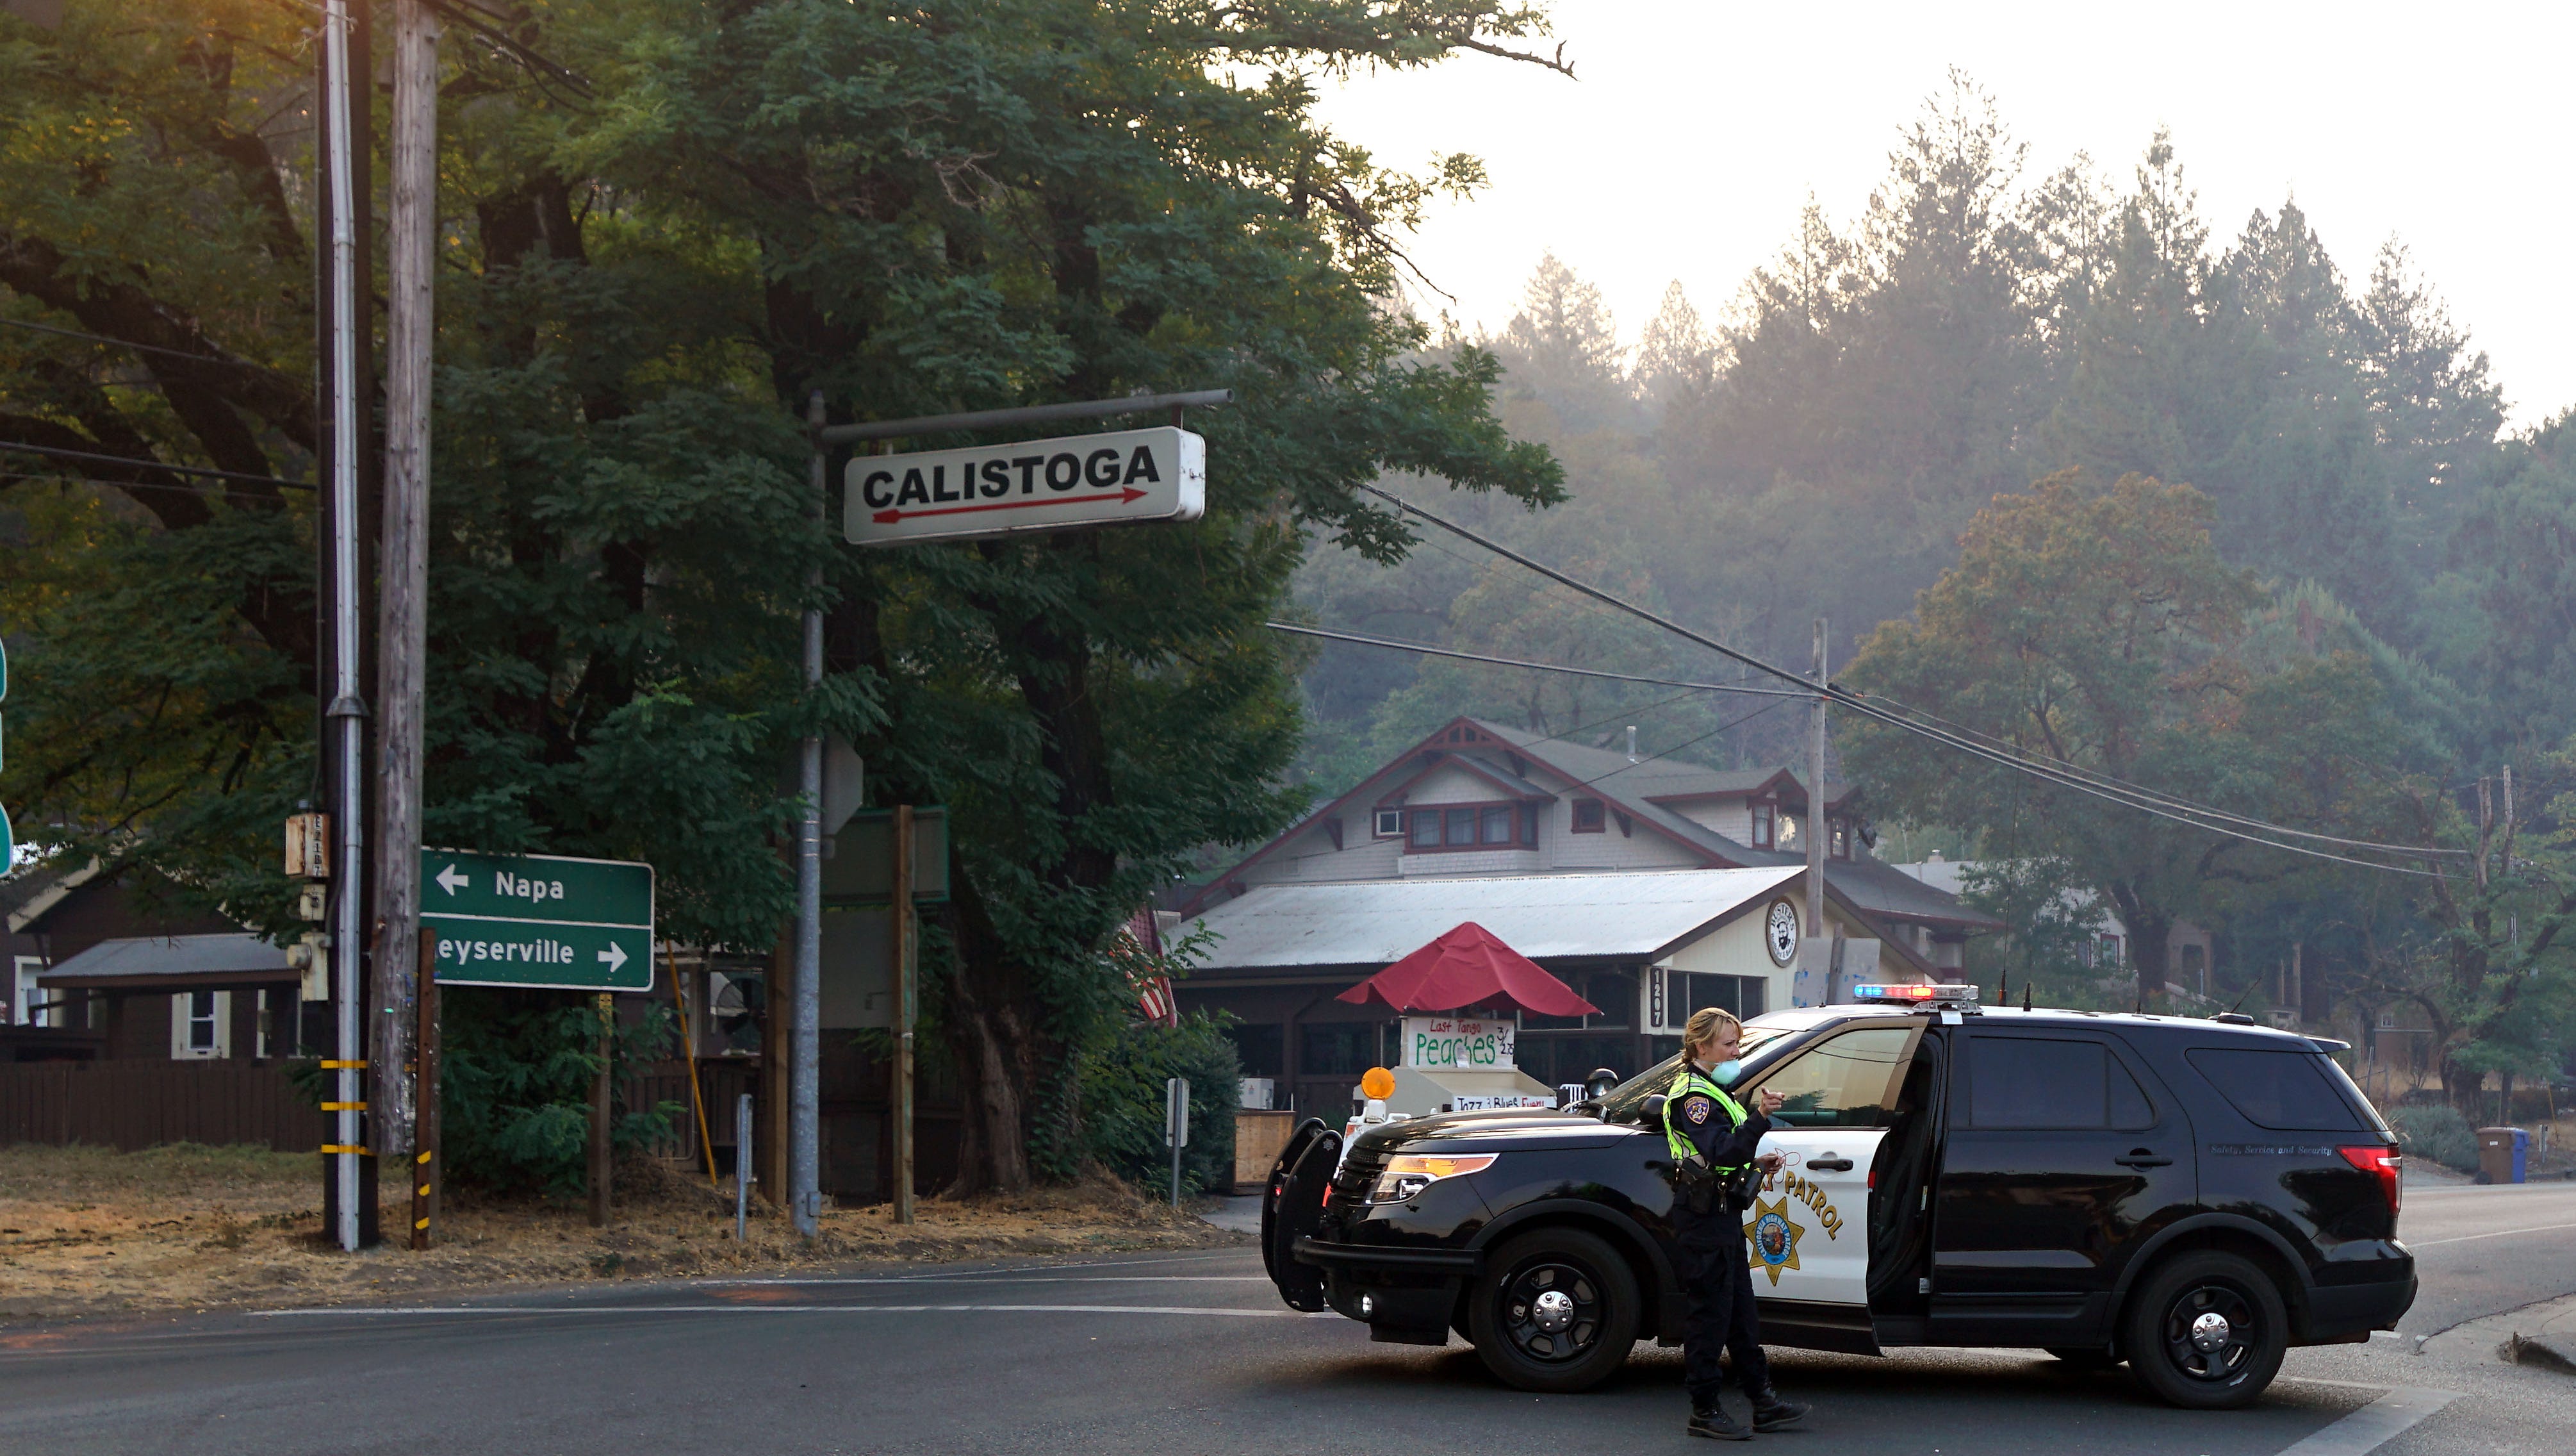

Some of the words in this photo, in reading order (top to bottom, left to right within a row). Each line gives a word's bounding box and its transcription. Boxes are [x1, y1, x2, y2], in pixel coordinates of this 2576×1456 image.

[863, 445, 1160, 508] CALISTOGA
[496, 871, 564, 904] Napa
[436, 938, 574, 966] eyserville
[1430, 1019, 1452, 1032] Last
[1457, 1020, 1481, 1035] Tango
[1416, 1033, 1495, 1065] Peaches
[2245, 1145, 2274, 1154] Service
[2277, 1145, 2294, 1154] and
[2298, 1145, 2332, 1156] Security
[1785, 1170, 1844, 1241] PATROL
[1782, 1232, 1791, 1257] PATROL
